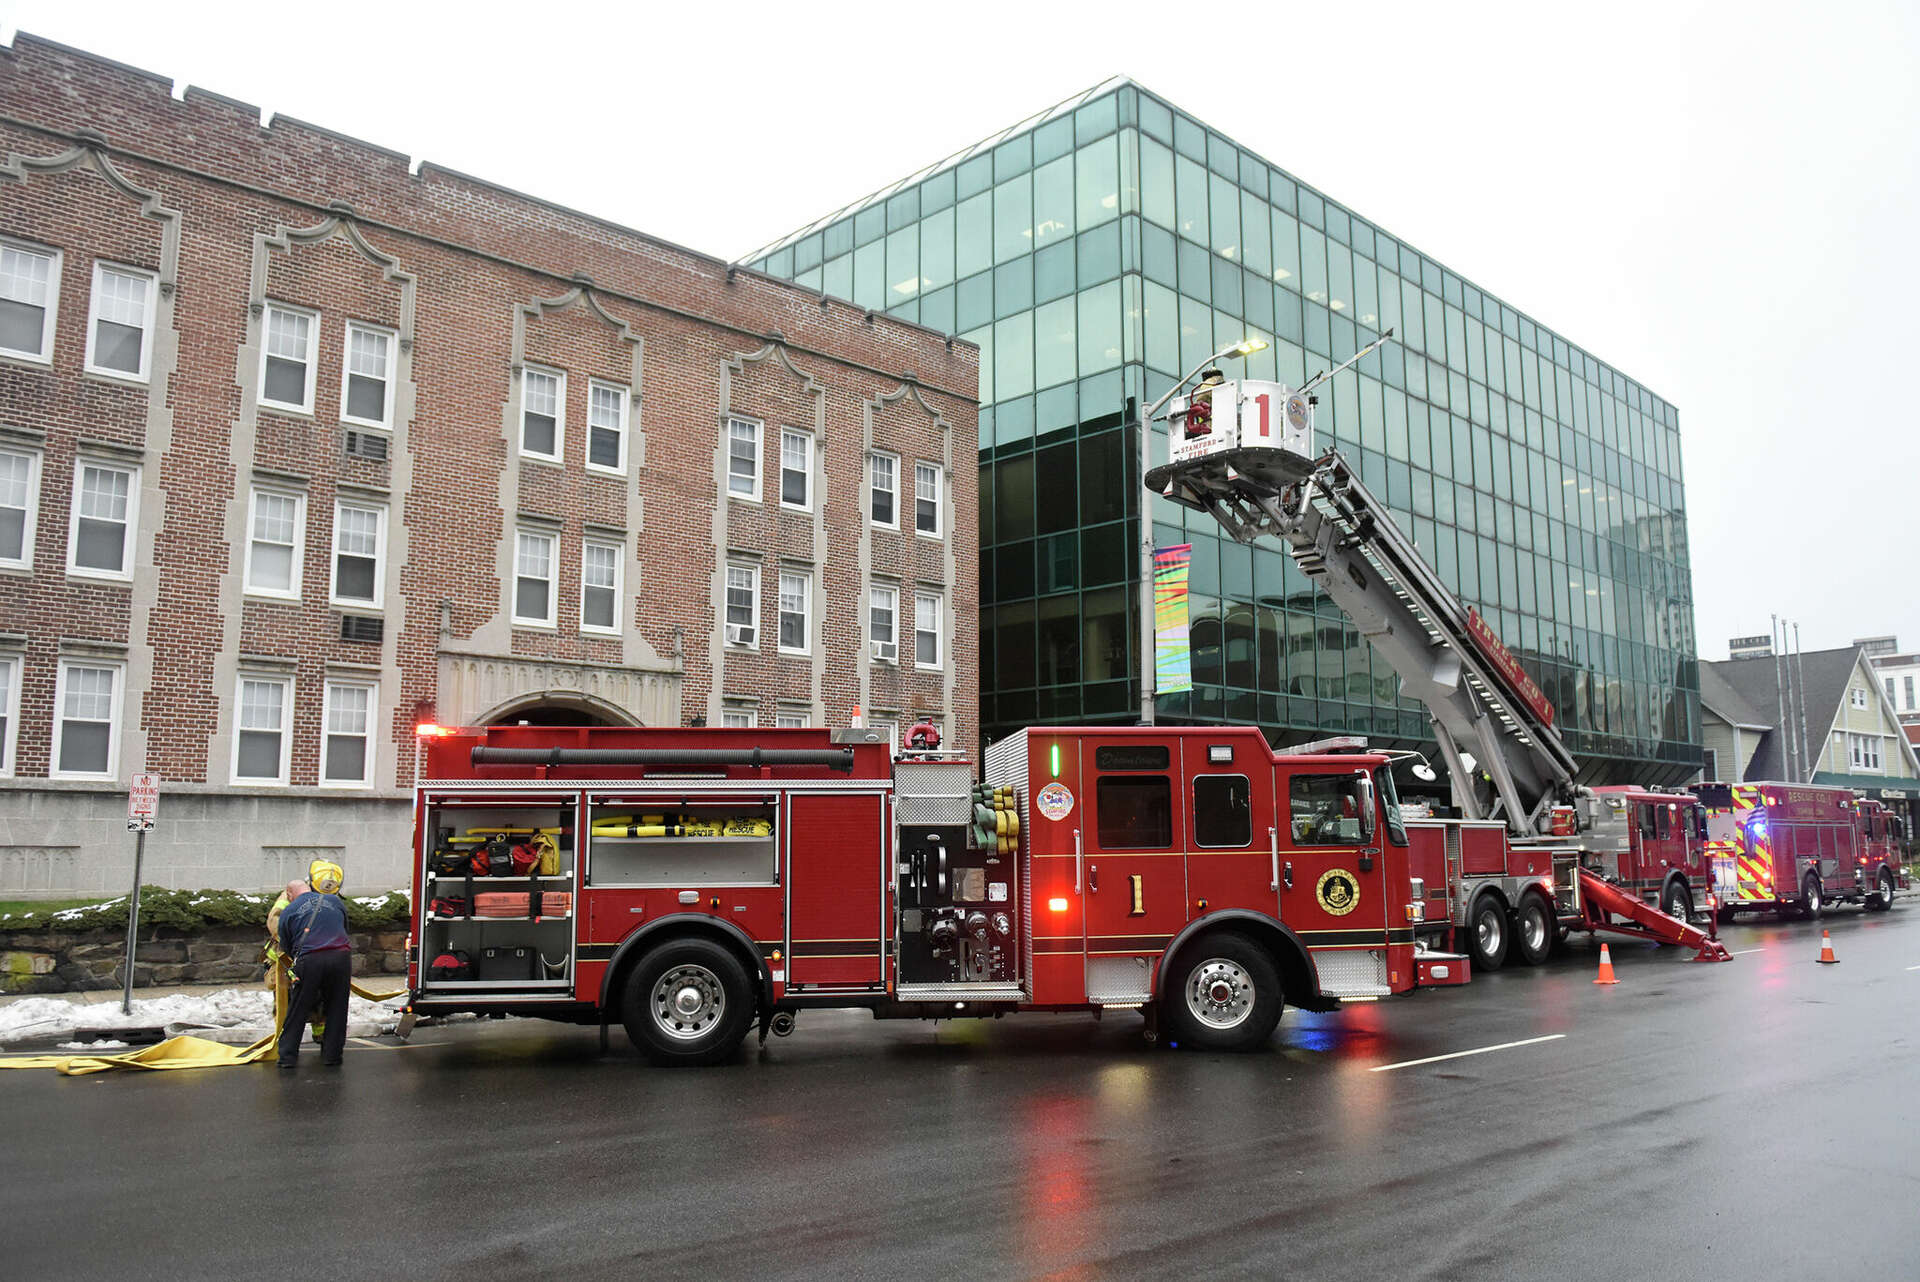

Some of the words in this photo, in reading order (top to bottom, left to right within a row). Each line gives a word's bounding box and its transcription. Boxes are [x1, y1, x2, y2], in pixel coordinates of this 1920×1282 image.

[1255, 394, 1269, 437] 1
[1180, 438, 1217, 453] STAMFORD
[1188, 447, 1209, 459] FIRE
[1476, 616, 1518, 672] TRUCK
[140, 777, 151, 786] NO
[132, 786, 158, 796] PARKING
[1788, 791, 1815, 803] RESCUE
[728, 826, 755, 835] RESCUE
[1128, 873, 1147, 917] 1
